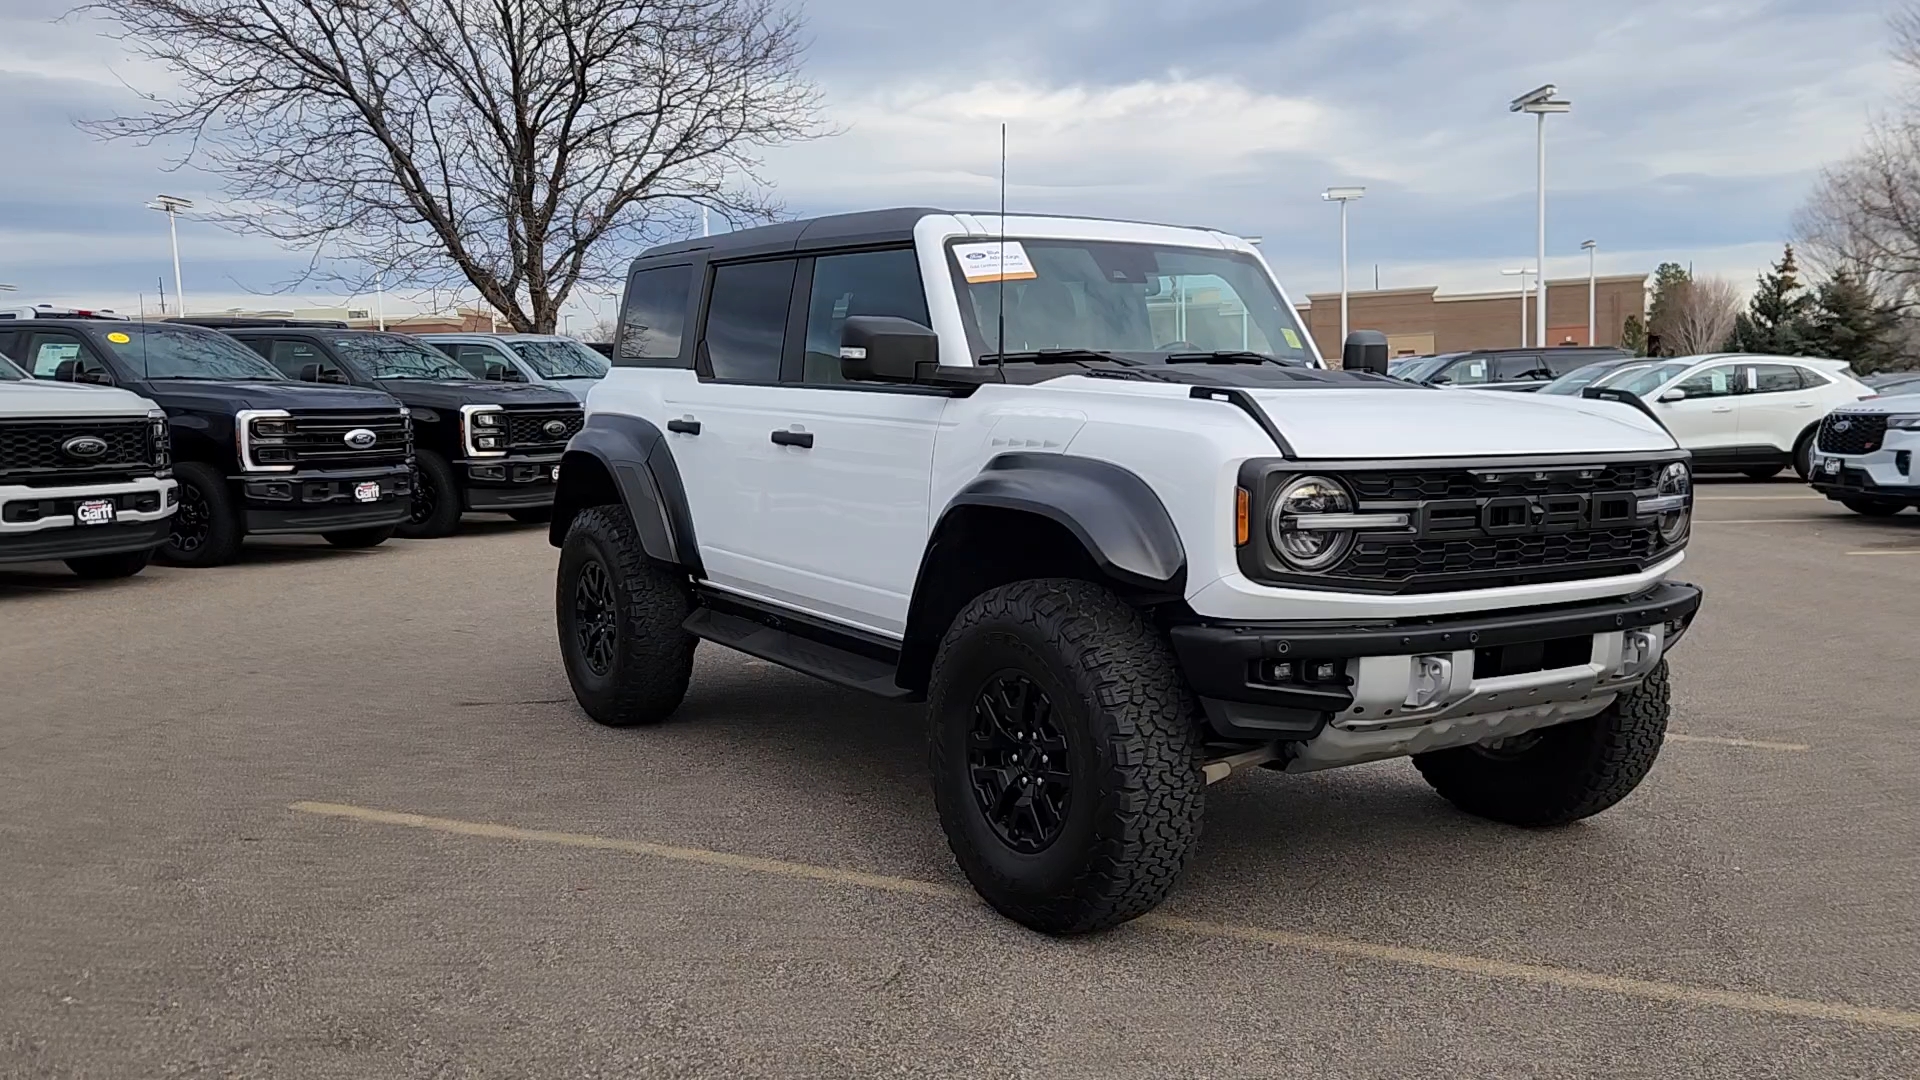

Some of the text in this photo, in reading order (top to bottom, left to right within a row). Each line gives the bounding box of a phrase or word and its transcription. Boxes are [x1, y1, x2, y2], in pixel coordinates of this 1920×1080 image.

[77, 442, 98, 452] Ford
[77, 503, 113, 521] Garff
[1419, 491, 1637, 538] FORD
